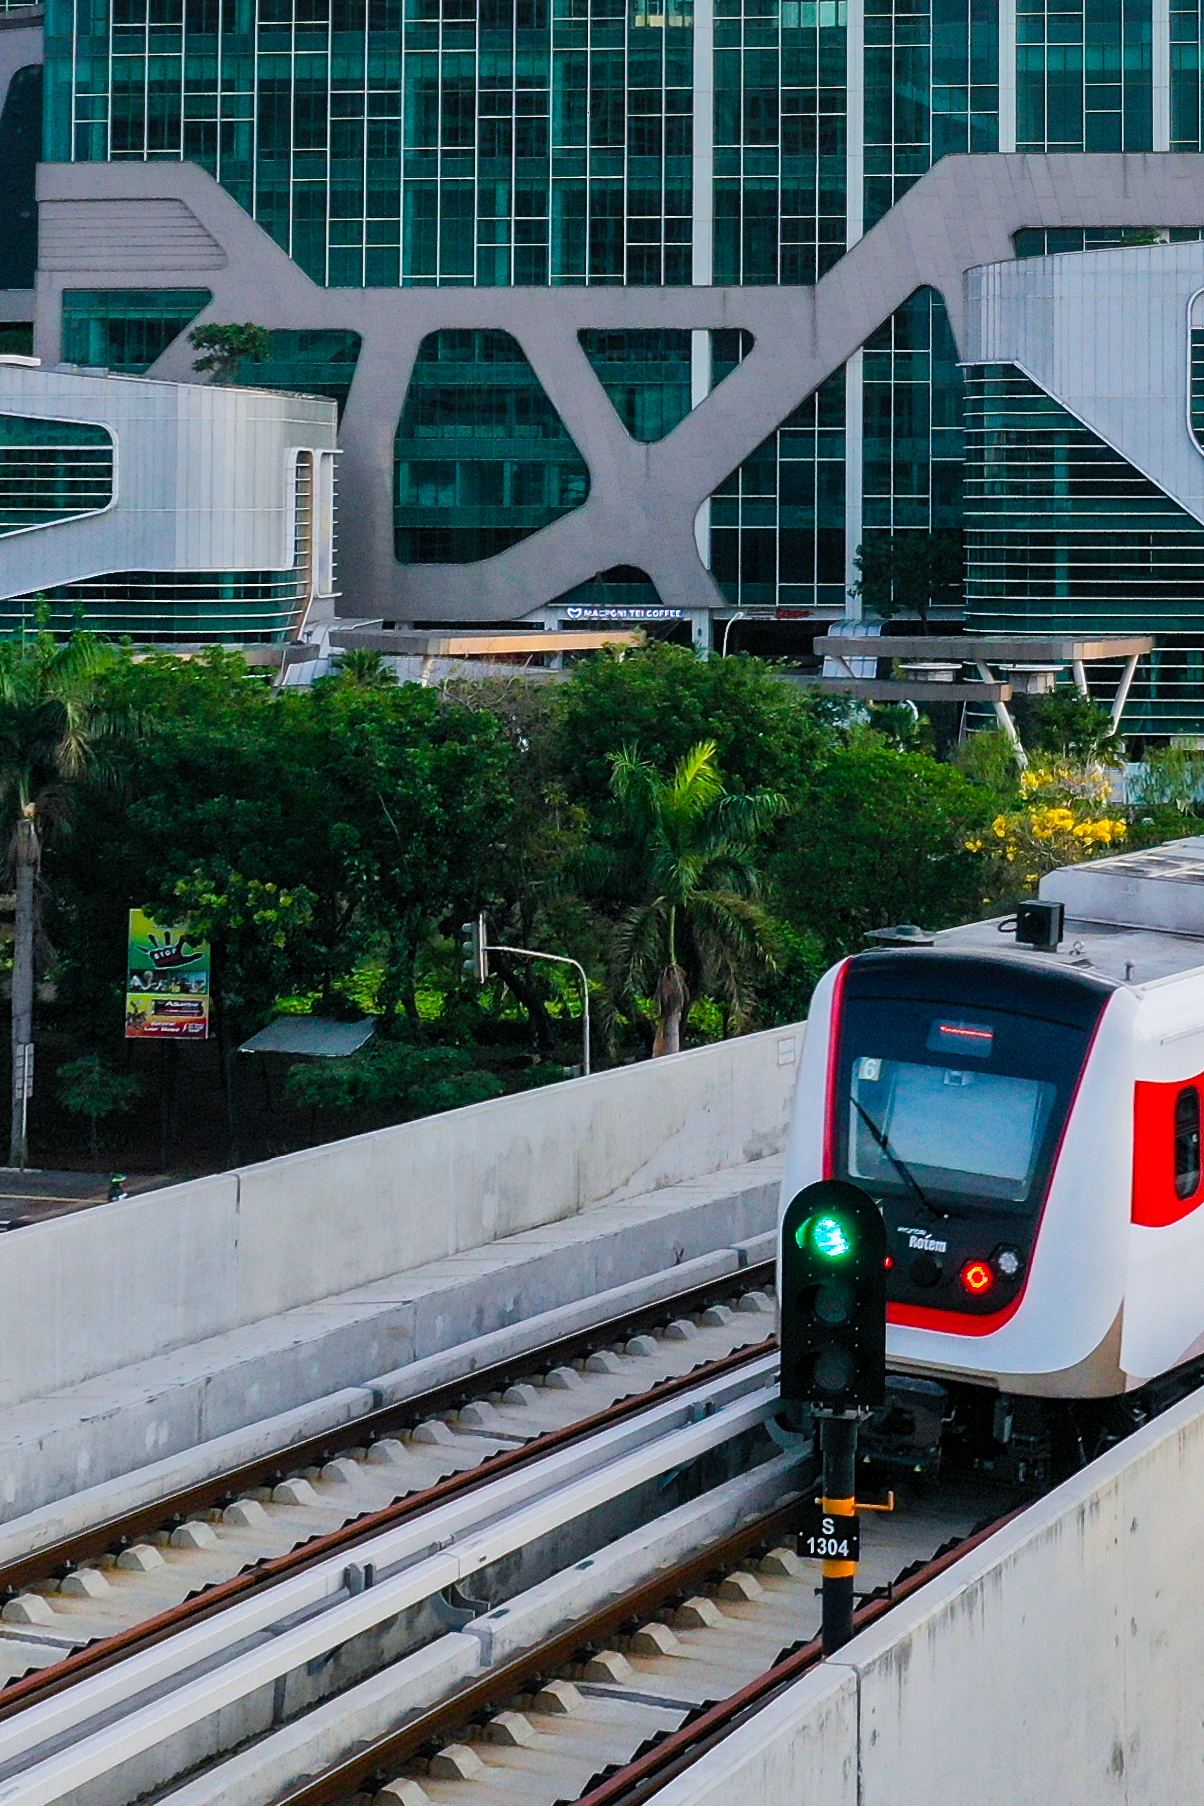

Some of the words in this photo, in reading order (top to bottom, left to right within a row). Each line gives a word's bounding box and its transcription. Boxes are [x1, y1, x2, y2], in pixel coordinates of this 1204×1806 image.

[646, 609, 682, 617] COFFEE
[154, 948, 177, 960] STOP
[863, 1060, 875, 1078] 6
[909, 1234, 947, 1252] Rotem
[822, 1518, 835, 1535] S
[807, 1537, 849, 1556] 1304
